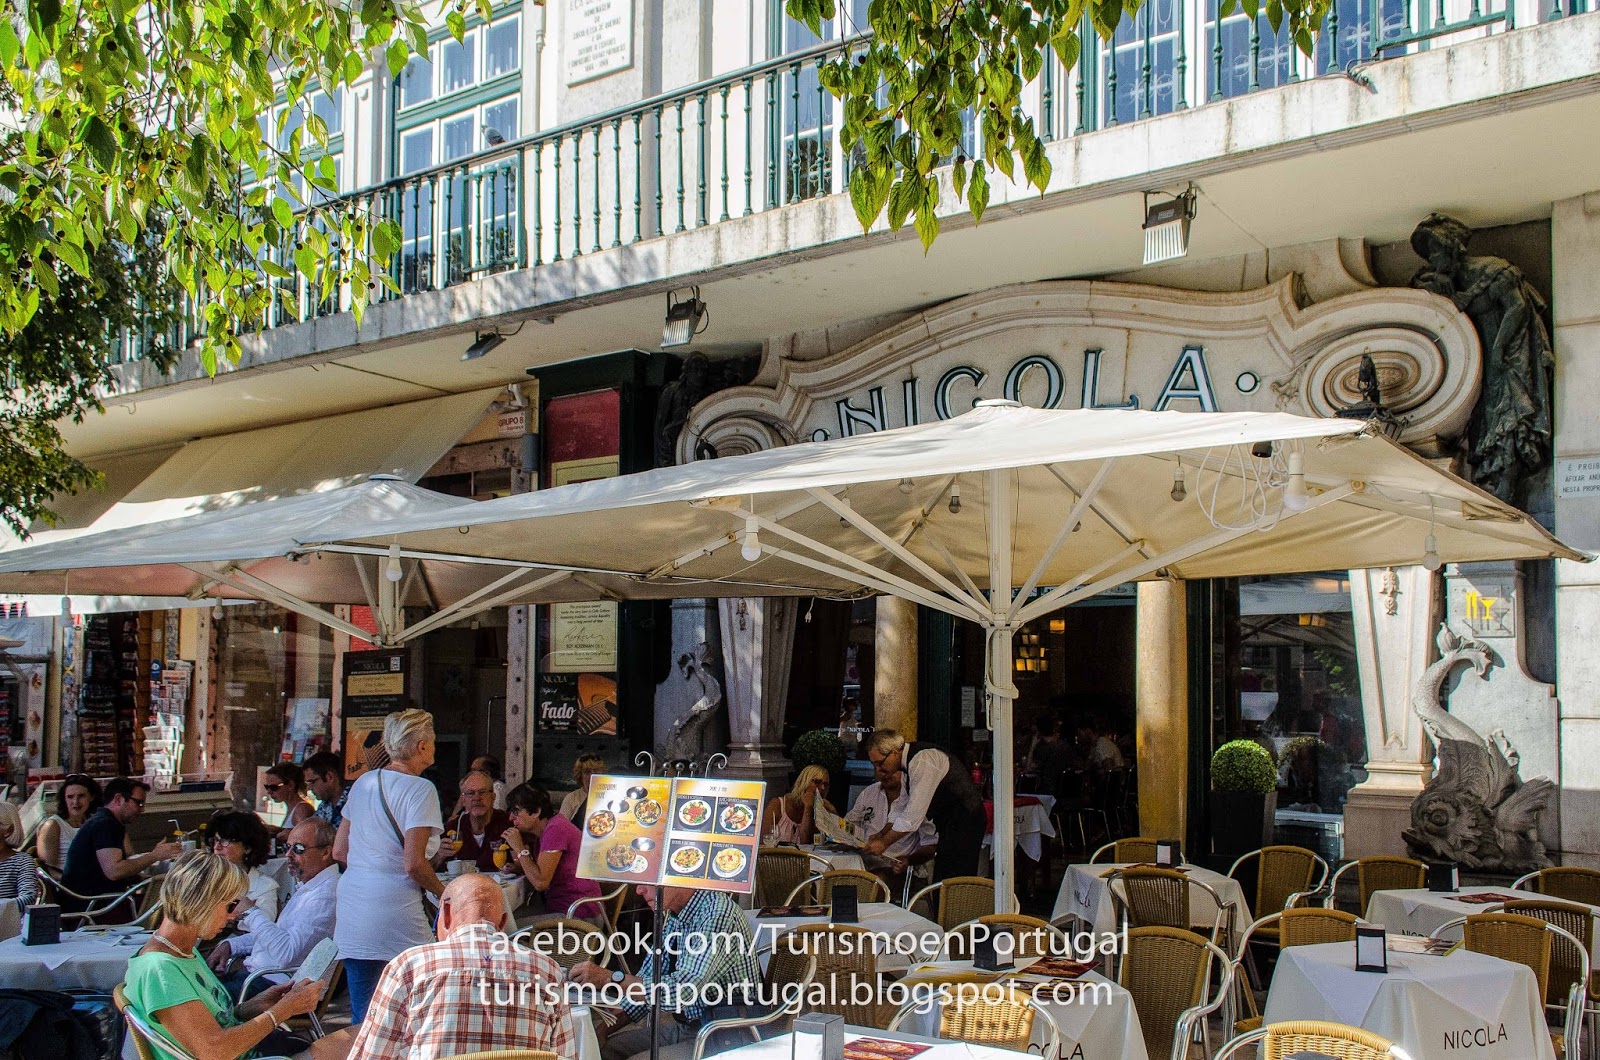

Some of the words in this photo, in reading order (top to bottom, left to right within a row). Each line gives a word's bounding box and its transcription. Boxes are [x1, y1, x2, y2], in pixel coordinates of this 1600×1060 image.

[835, 345, 1219, 438] NICOLA
[498, 416, 519, 427] GRUPO
[1565, 474, 1585, 482] AFIXAR
[541, 701, 577, 719] Fado
[1443, 1022, 1508, 1050] NICOLA
